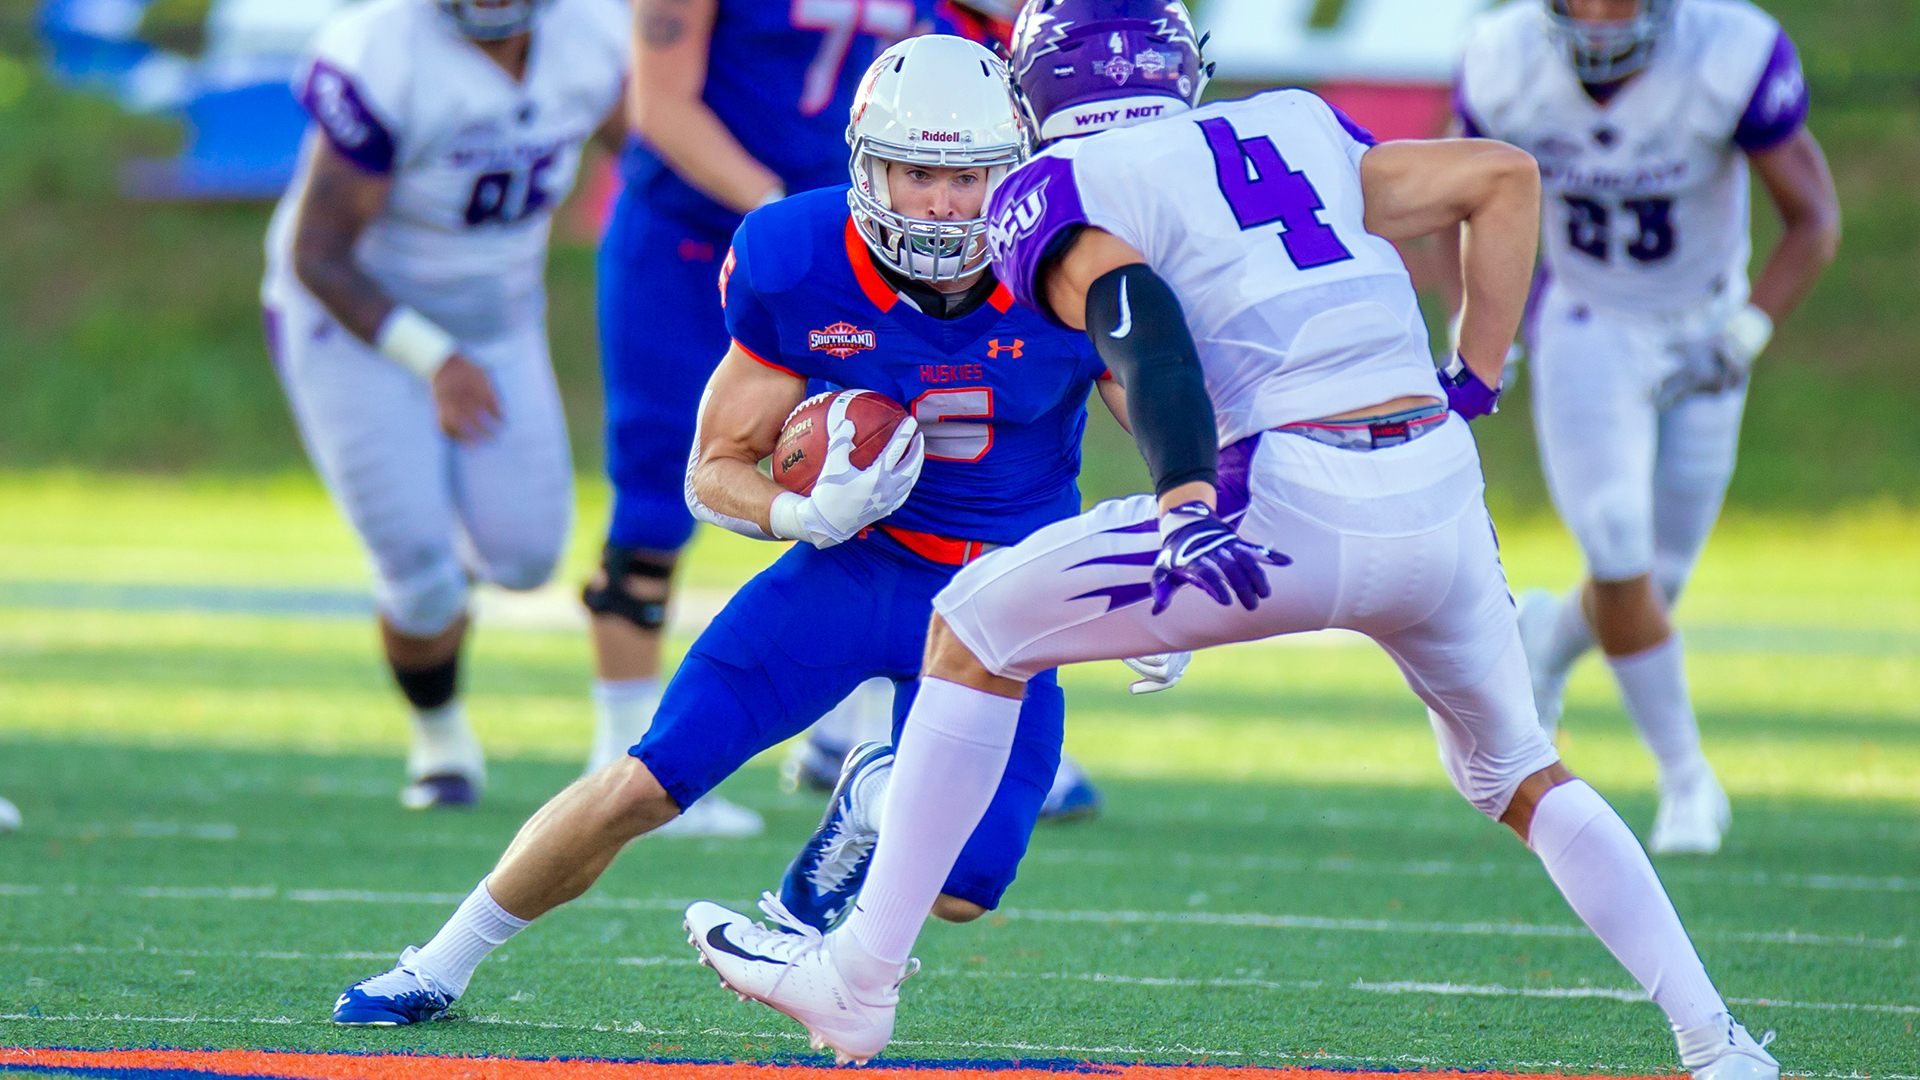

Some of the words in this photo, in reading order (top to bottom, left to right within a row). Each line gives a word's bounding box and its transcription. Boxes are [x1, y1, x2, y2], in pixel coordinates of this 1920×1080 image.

[1109, 32, 1122, 53] 4
[1075, 109, 1120, 126] WHY
[1126, 105, 1164, 119] NOT
[921, 130, 960, 143] Riddell
[1194, 116, 1355, 271] 4
[1559, 194, 1677, 265] 23
[810, 332, 874, 348] SOUTHLAND
[919, 363, 983, 383] HUSKIES
[781, 447, 806, 474] NCAA
